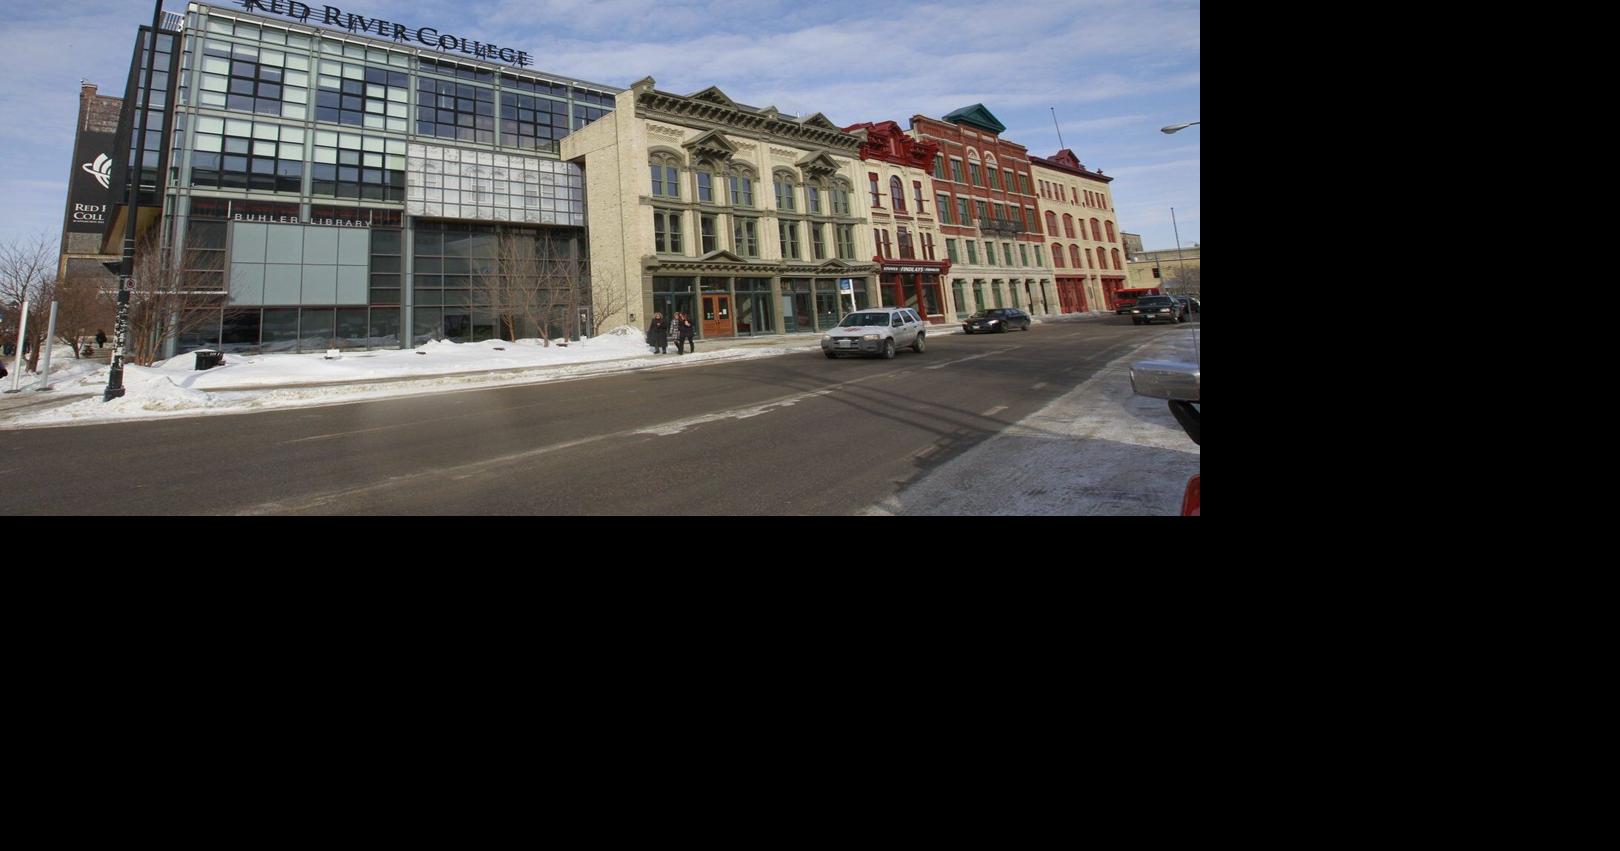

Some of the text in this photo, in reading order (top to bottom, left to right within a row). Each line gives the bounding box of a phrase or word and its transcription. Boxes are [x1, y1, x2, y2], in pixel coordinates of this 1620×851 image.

[322, 5, 410, 42] RIVER
[416, 27, 529, 66] COLLEGE
[75, 203, 99, 211] RED
[234, 213, 371, 227] BUHLER LIBRARY
